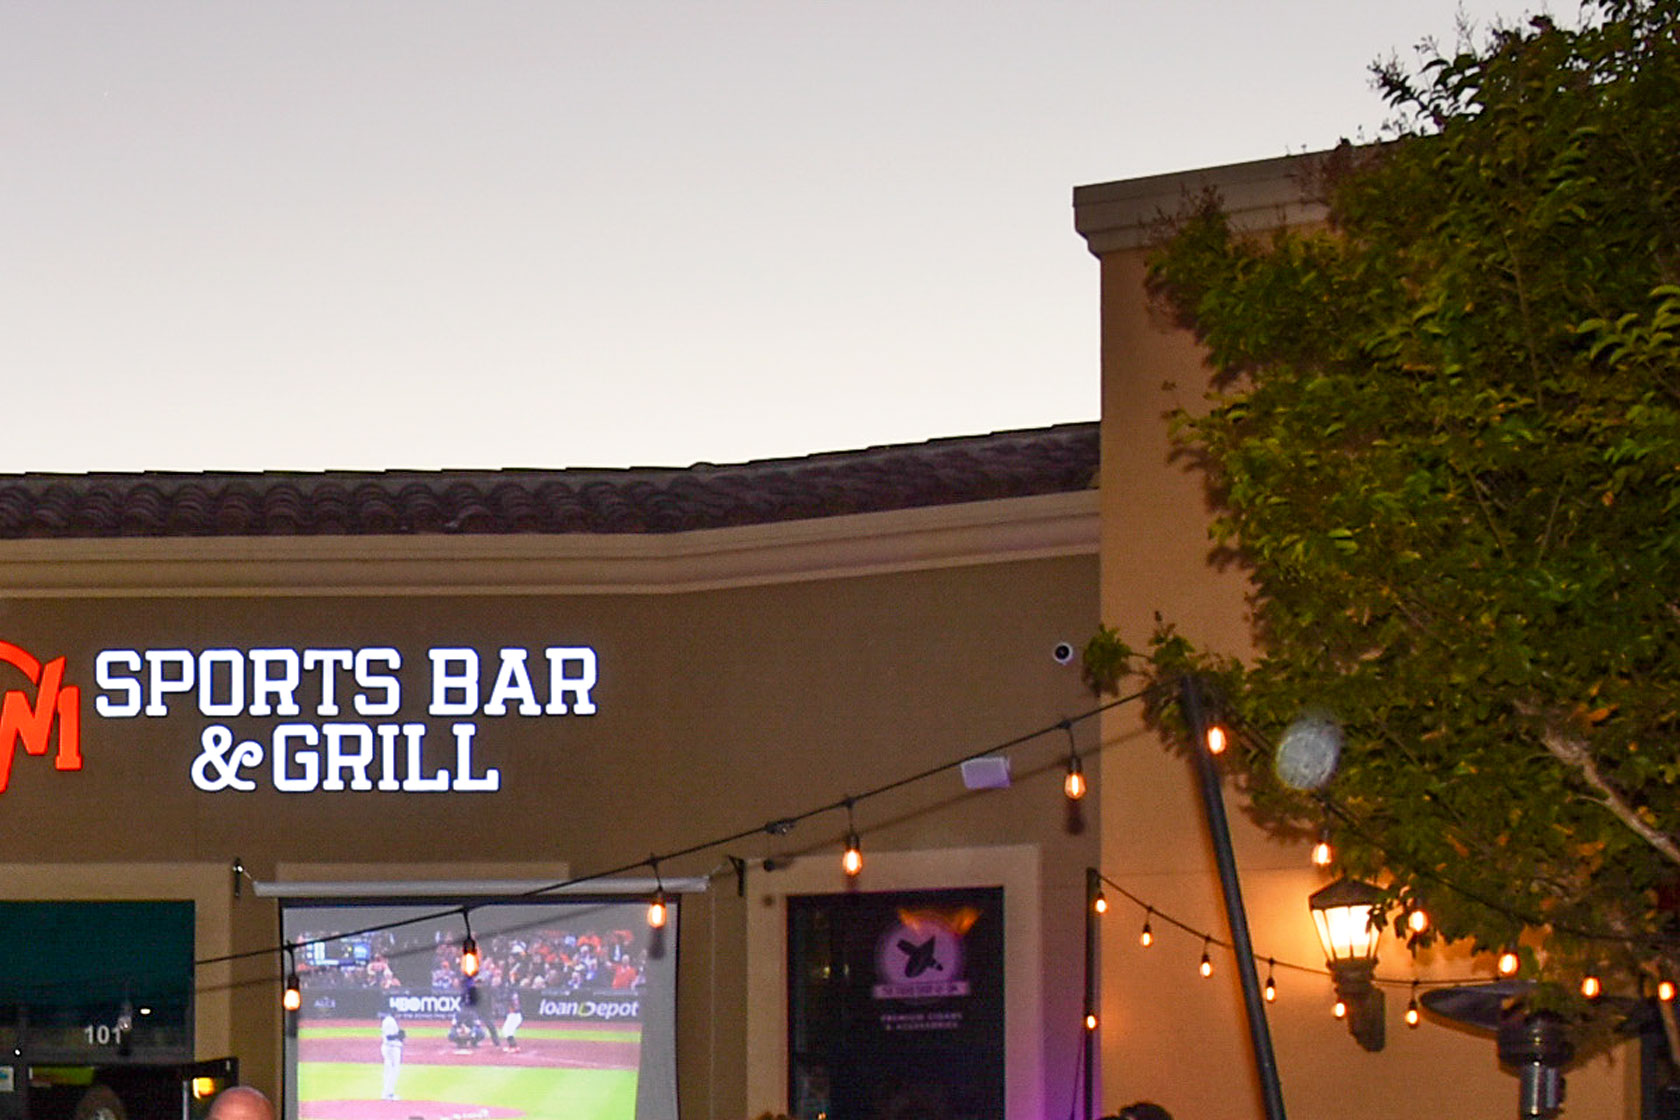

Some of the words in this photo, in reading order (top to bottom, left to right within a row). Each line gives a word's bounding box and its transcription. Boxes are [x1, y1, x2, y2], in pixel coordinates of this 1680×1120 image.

[95, 647, 403, 717] SPORTS
[429, 647, 599, 717] BAR
[539, 999, 639, 1020] loanDepot
[85, 1024, 122, 1044] 101
